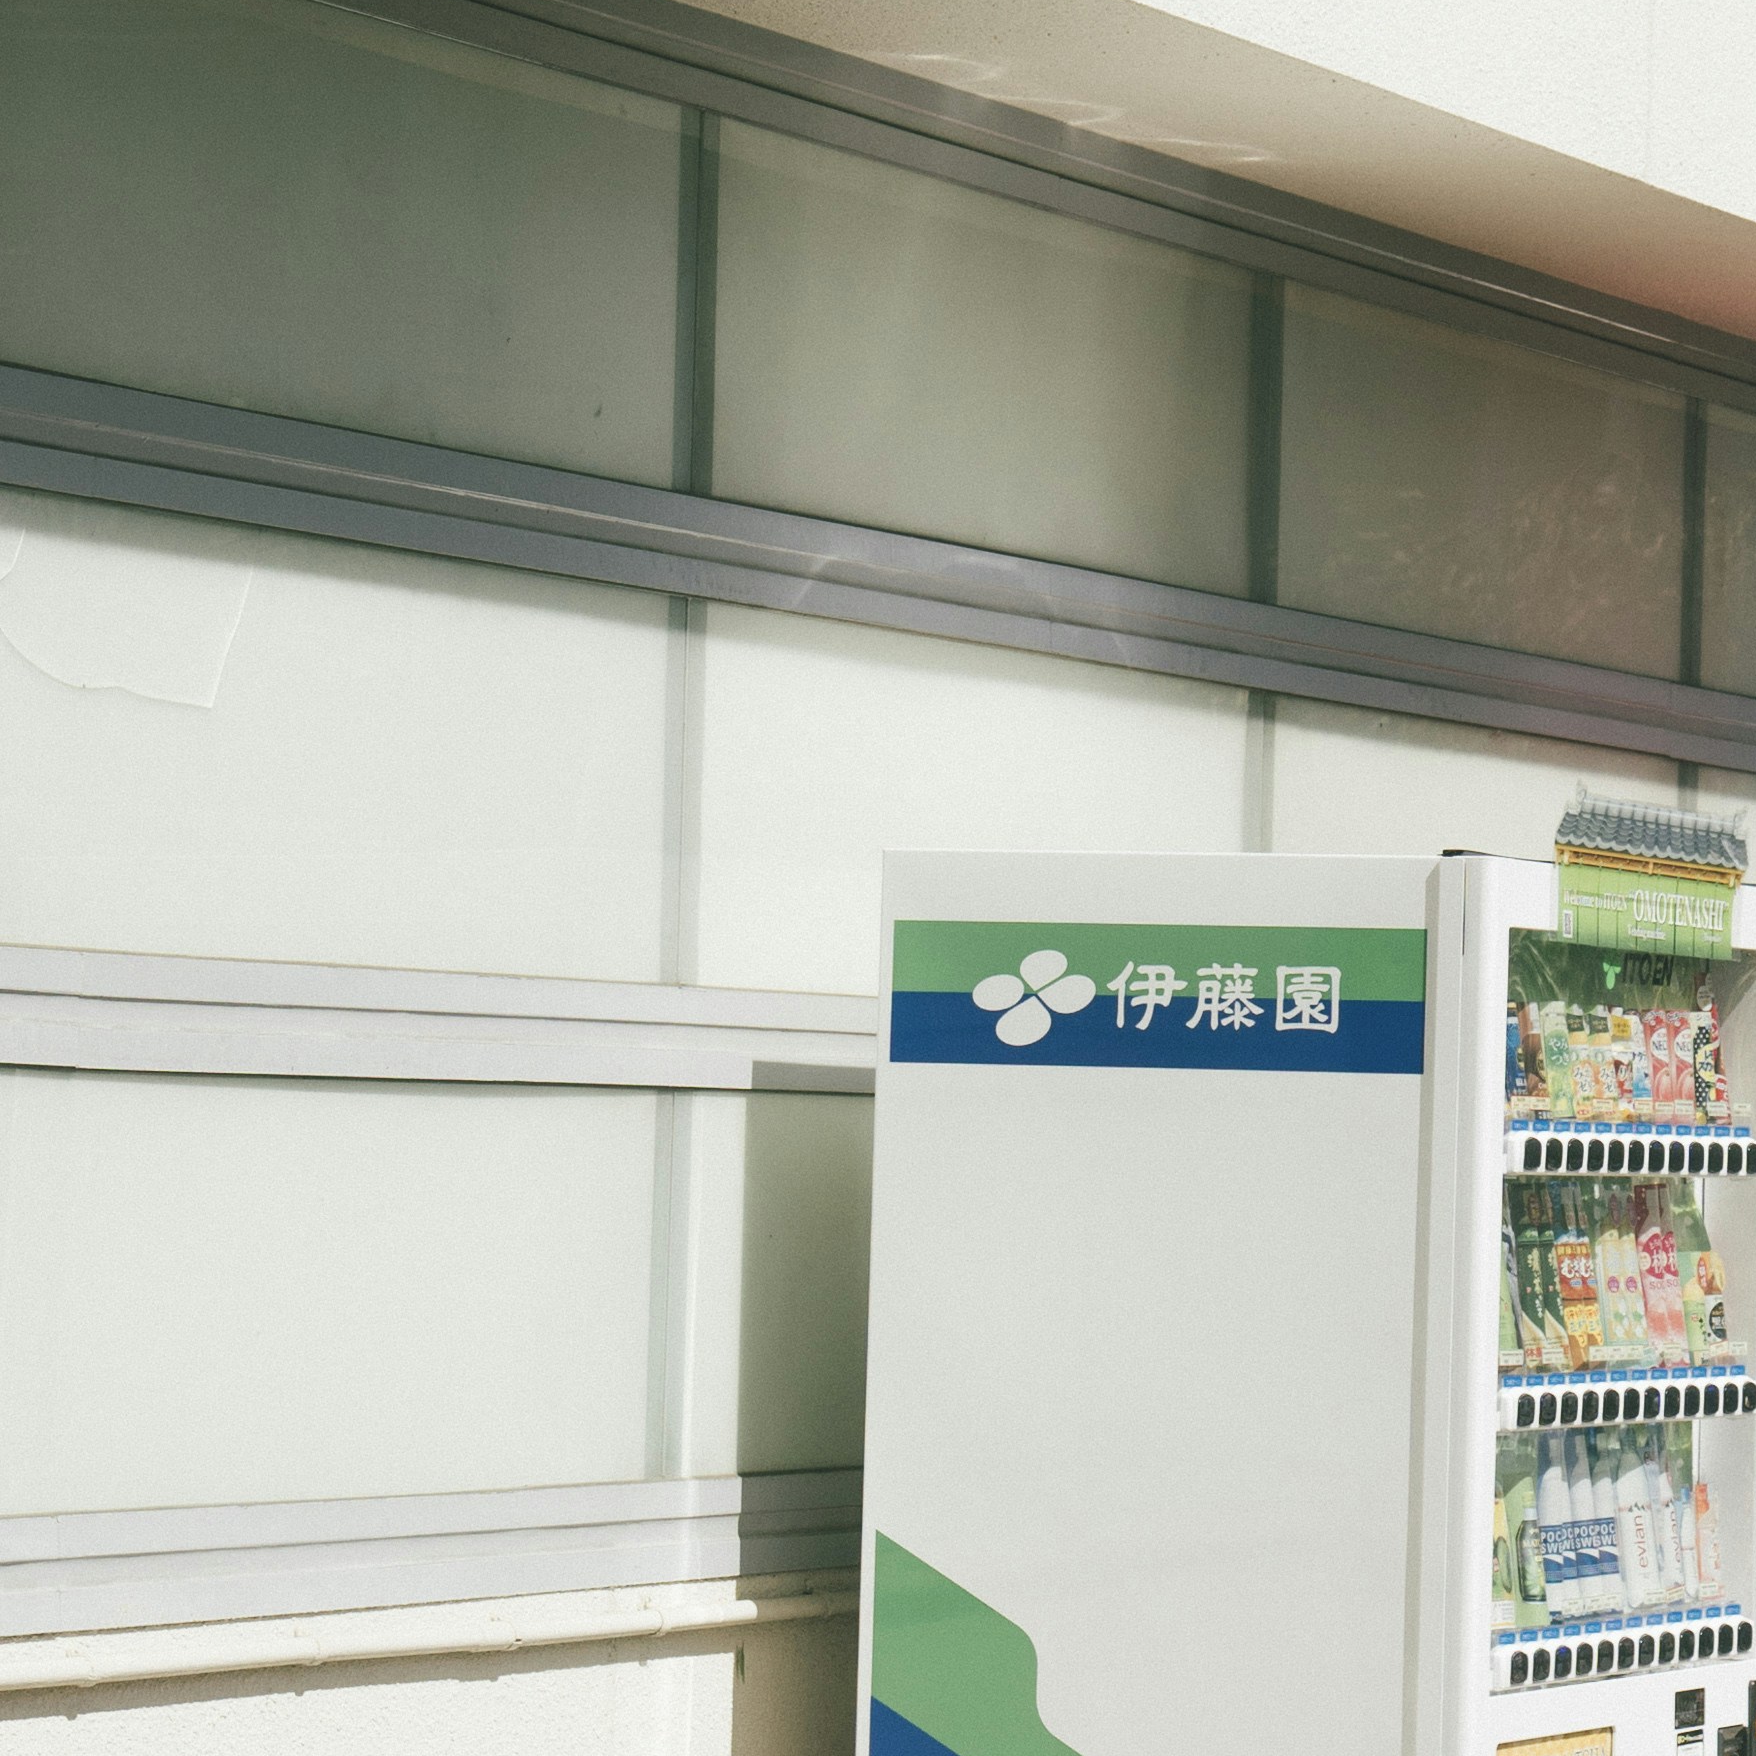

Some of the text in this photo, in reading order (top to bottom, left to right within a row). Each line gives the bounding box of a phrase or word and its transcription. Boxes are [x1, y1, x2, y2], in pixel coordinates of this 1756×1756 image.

[1106, 961, 1342, 1034] 伊藤園
[1633, 1514, 1648, 1569] evian
